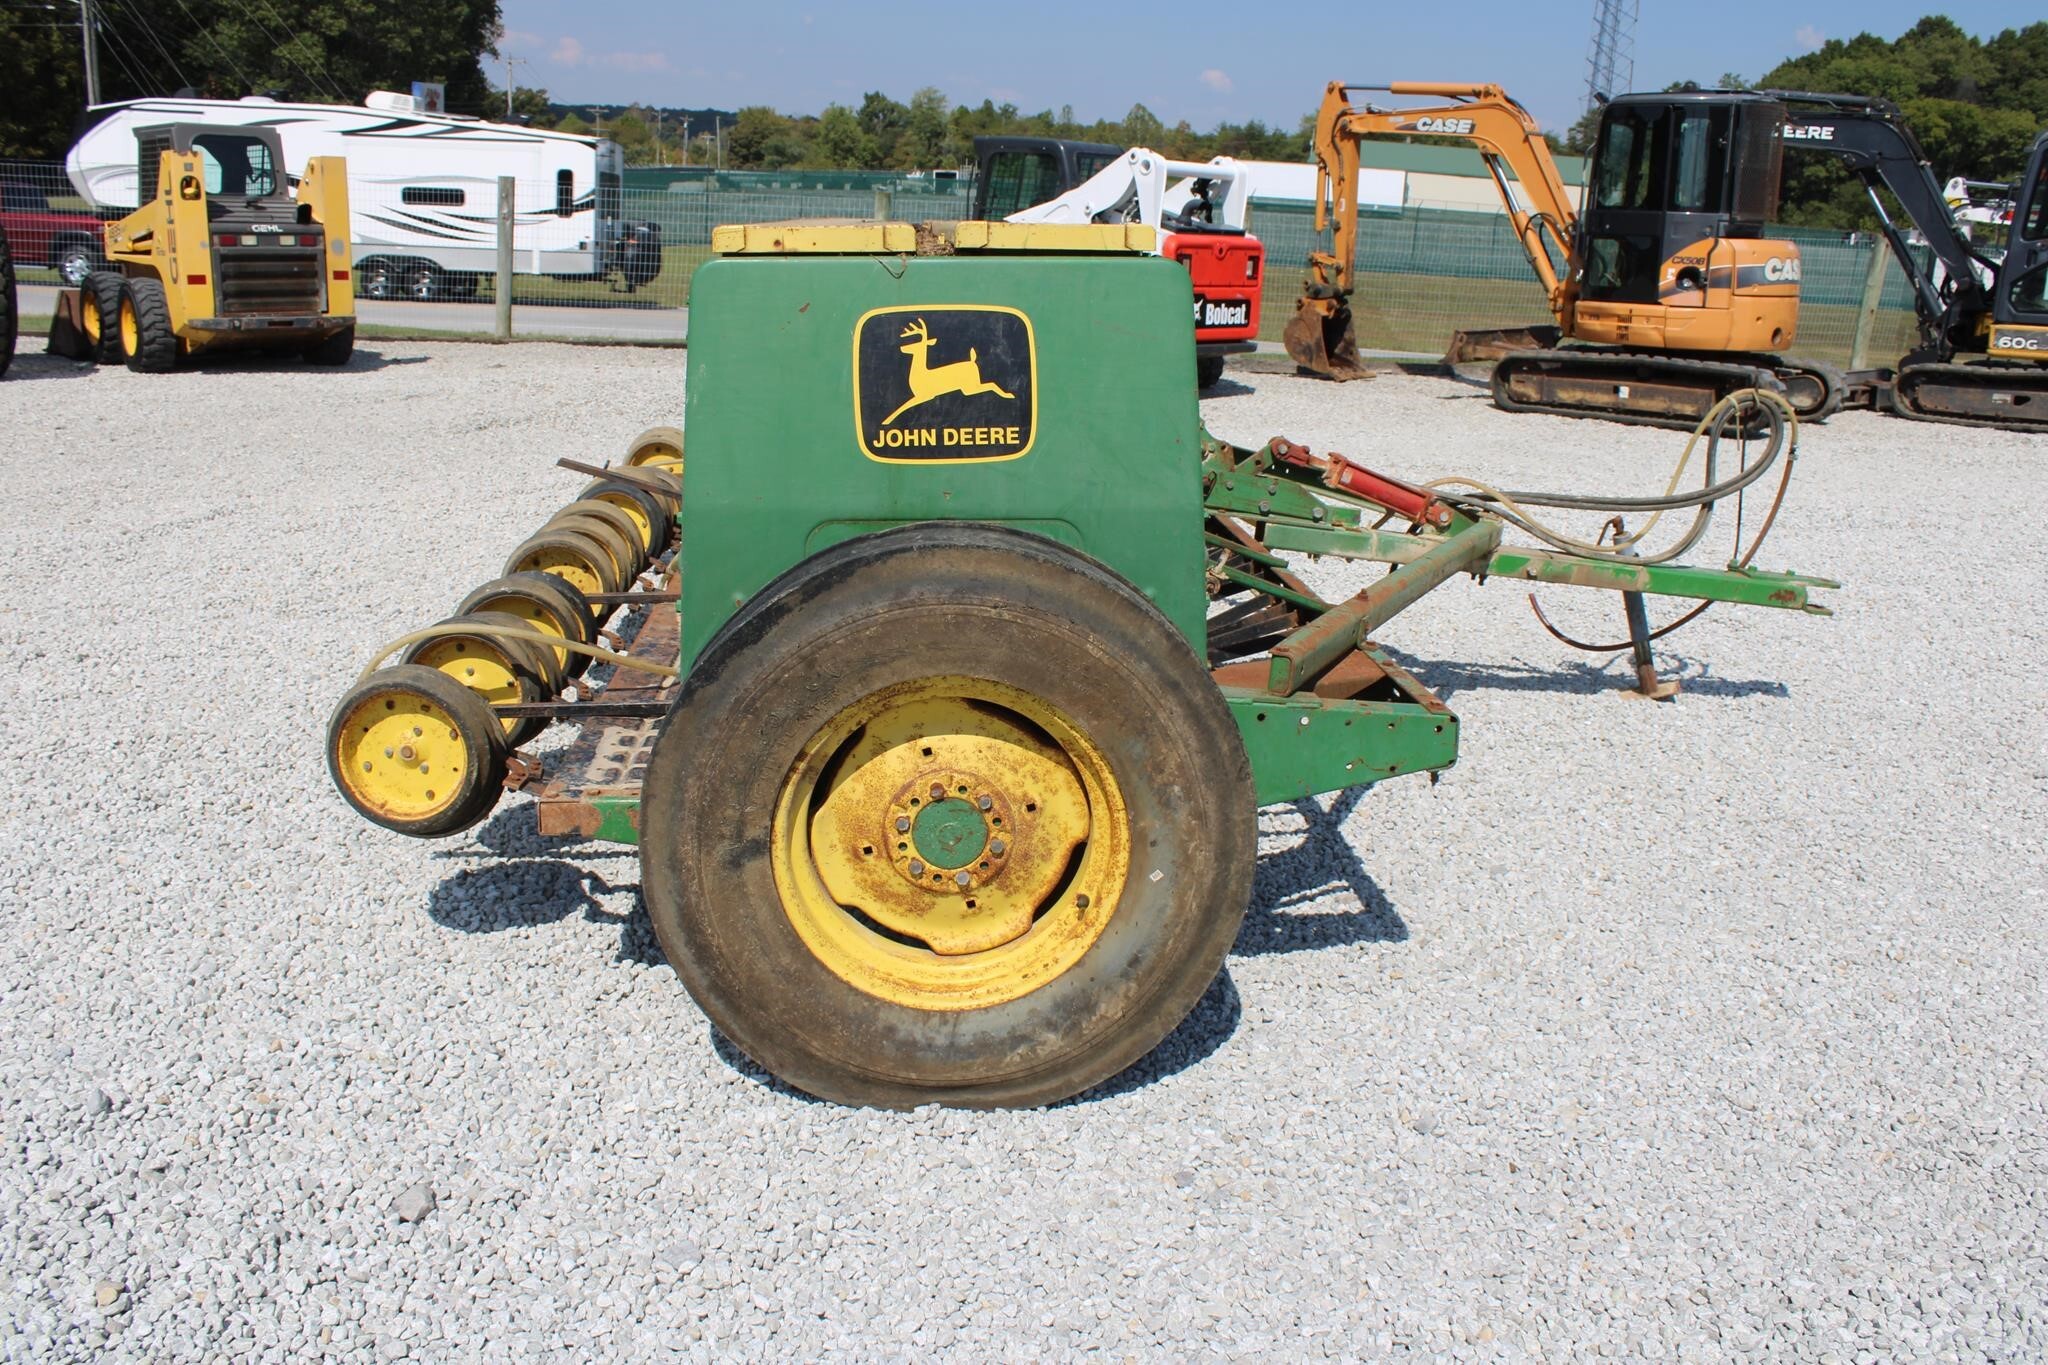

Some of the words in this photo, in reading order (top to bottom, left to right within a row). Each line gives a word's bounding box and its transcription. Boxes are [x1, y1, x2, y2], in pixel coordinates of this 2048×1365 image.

[1416, 116, 1473, 134] CASE
[251, 224, 283, 233] GEHL
[1764, 257, 1800, 281] CAS
[1205, 303, 1246, 326] Bobcat
[1999, 336, 2038, 350] 60G
[873, 428, 937, 448] JOHN
[943, 426, 1020, 446] DEERE
